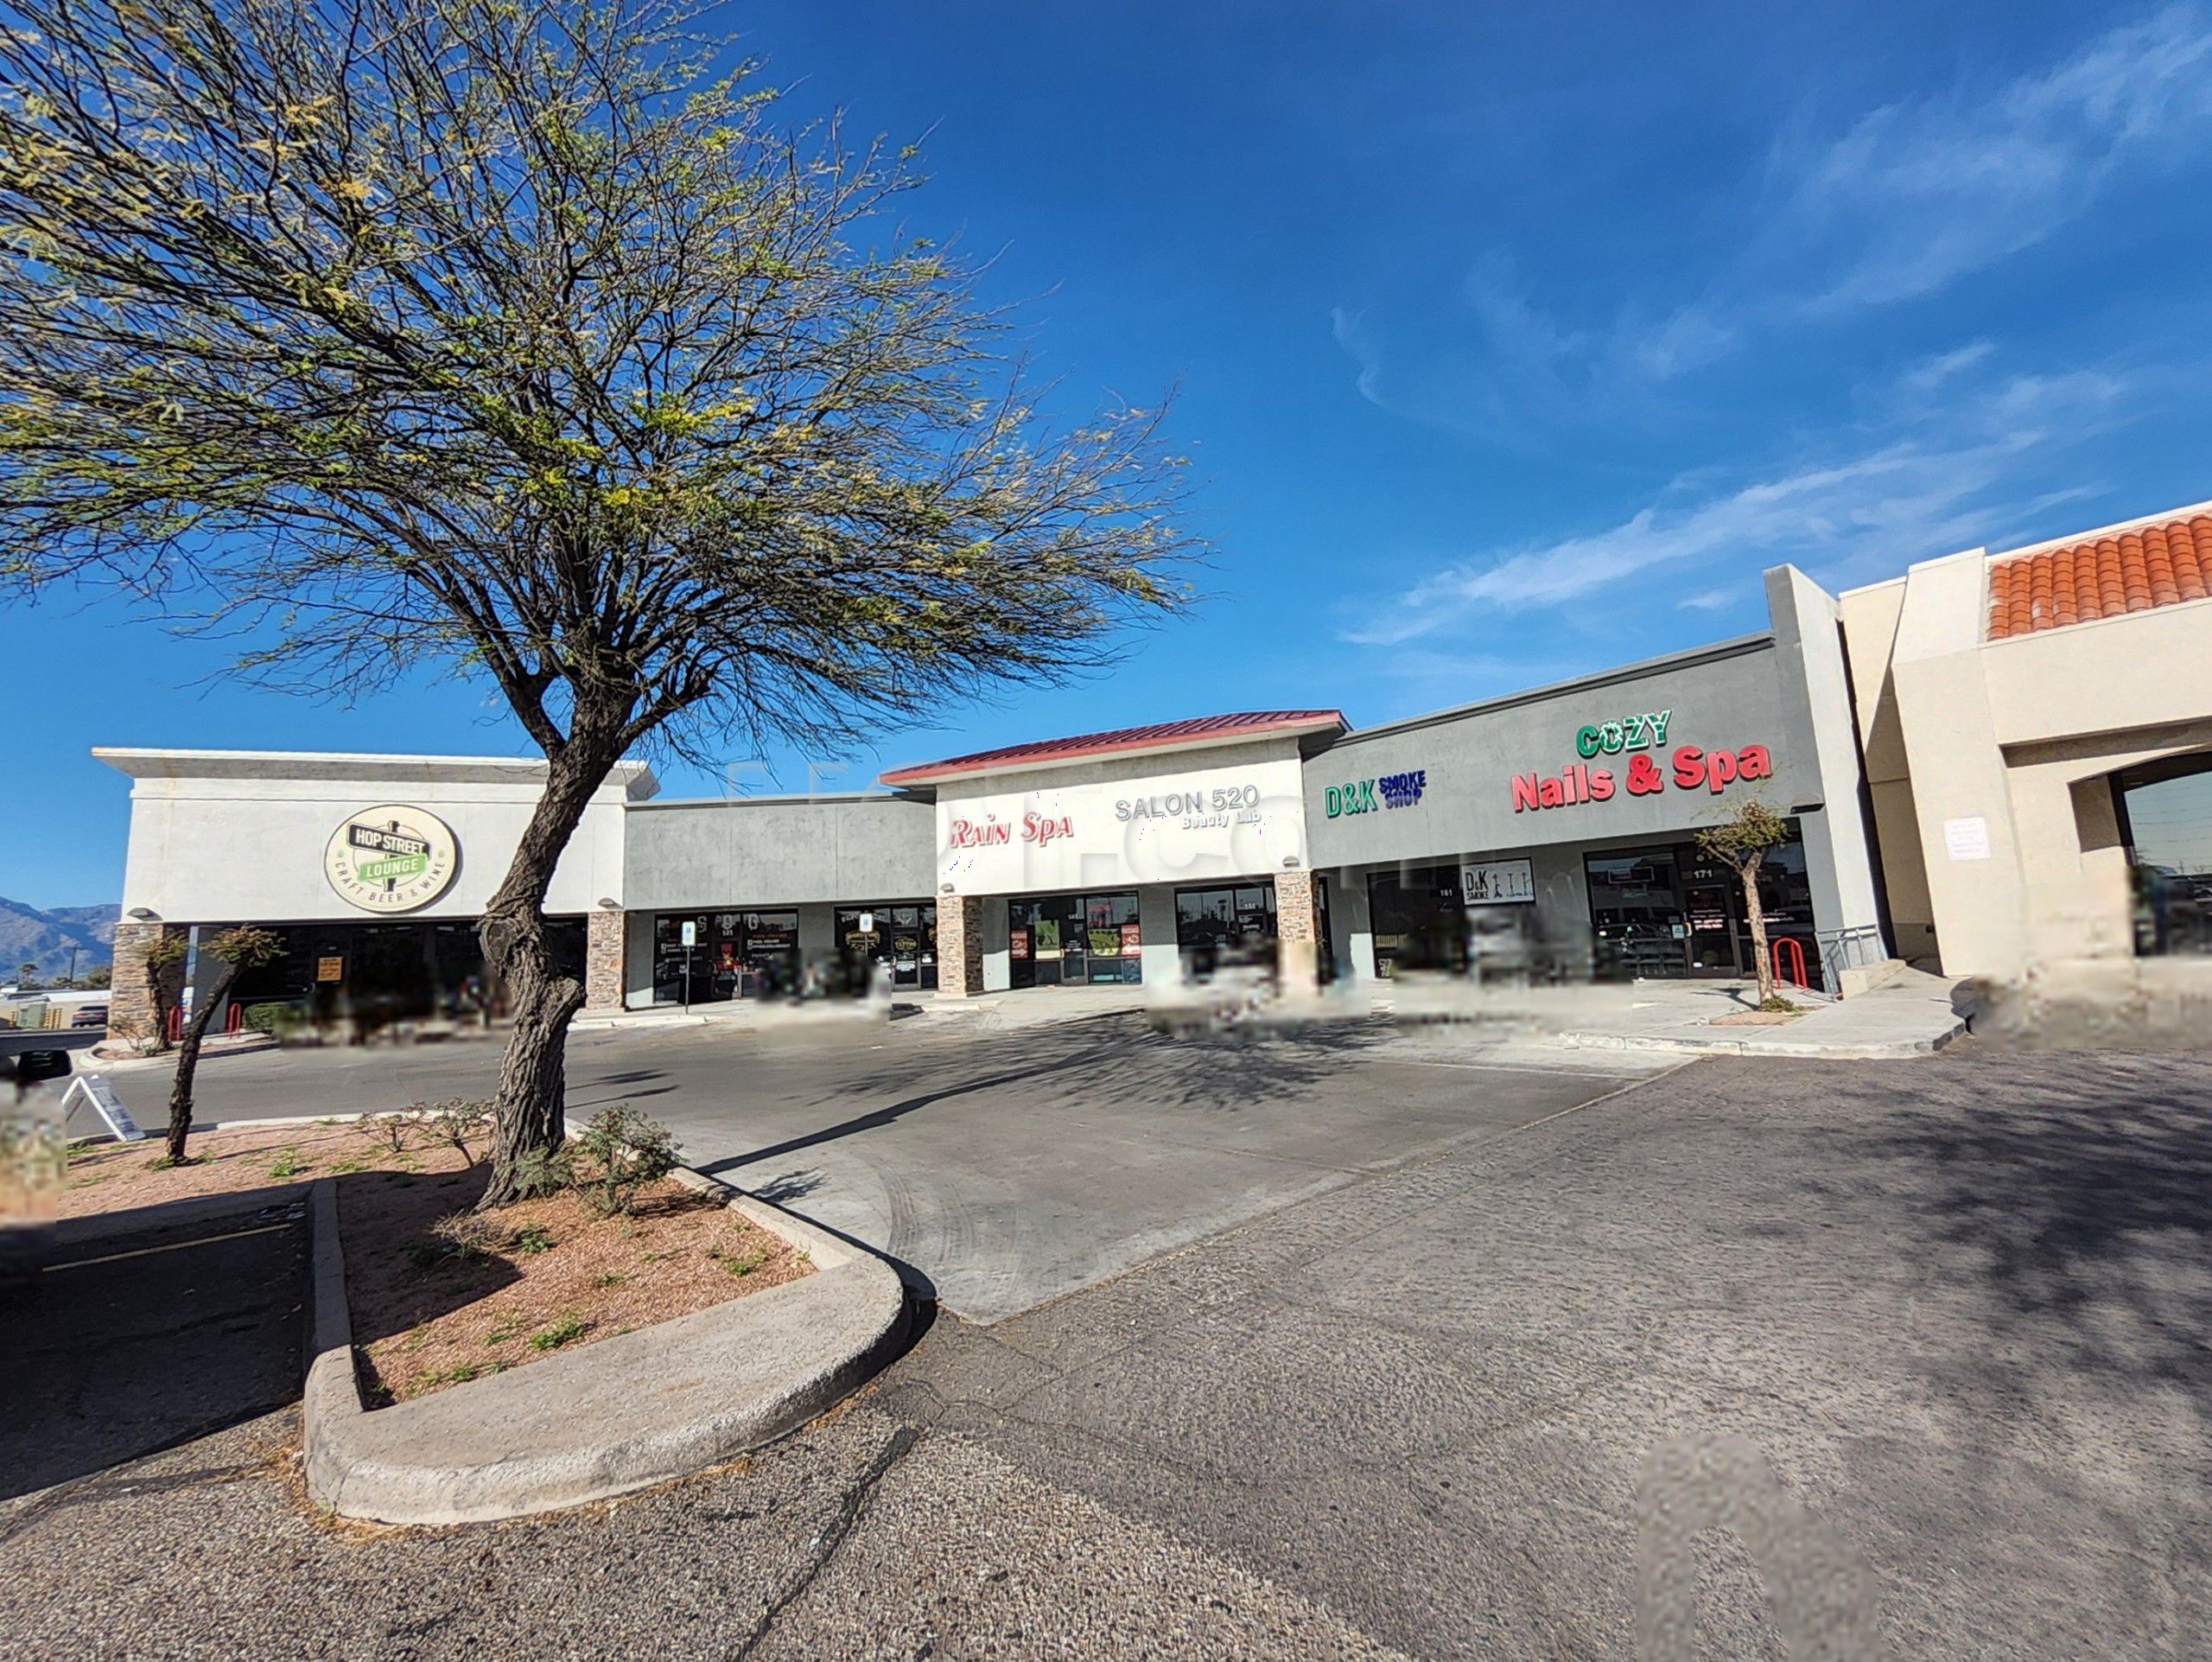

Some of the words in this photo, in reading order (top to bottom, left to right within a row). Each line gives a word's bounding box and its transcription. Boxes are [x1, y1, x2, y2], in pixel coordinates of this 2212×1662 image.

[1576, 709, 1674, 760] COZY
[1378, 769, 1427, 794] SMOKE
[1511, 764, 1616, 813] Nails
[1626, 753, 1664, 797] &
[1673, 744, 1773, 795] Spa
[1116, 792, 1204, 821] SALON
[1211, 785, 1261, 811] 520
[1325, 779, 1378, 819] D&K
[1384, 787, 1422, 810] SHOP
[1182, 813, 1230, 830] Beauty
[355, 828, 382, 847] HOP
[383, 836, 425, 854] STREET
[365, 858, 419, 877] LOUNGE
[1694, 869, 1713, 879] 171
[334, 862, 364, 895] CRAFT
[368, 891, 404, 903] BEER
[420, 863, 445, 889] WINE
[1466, 891, 1490, 900] SMOKE
